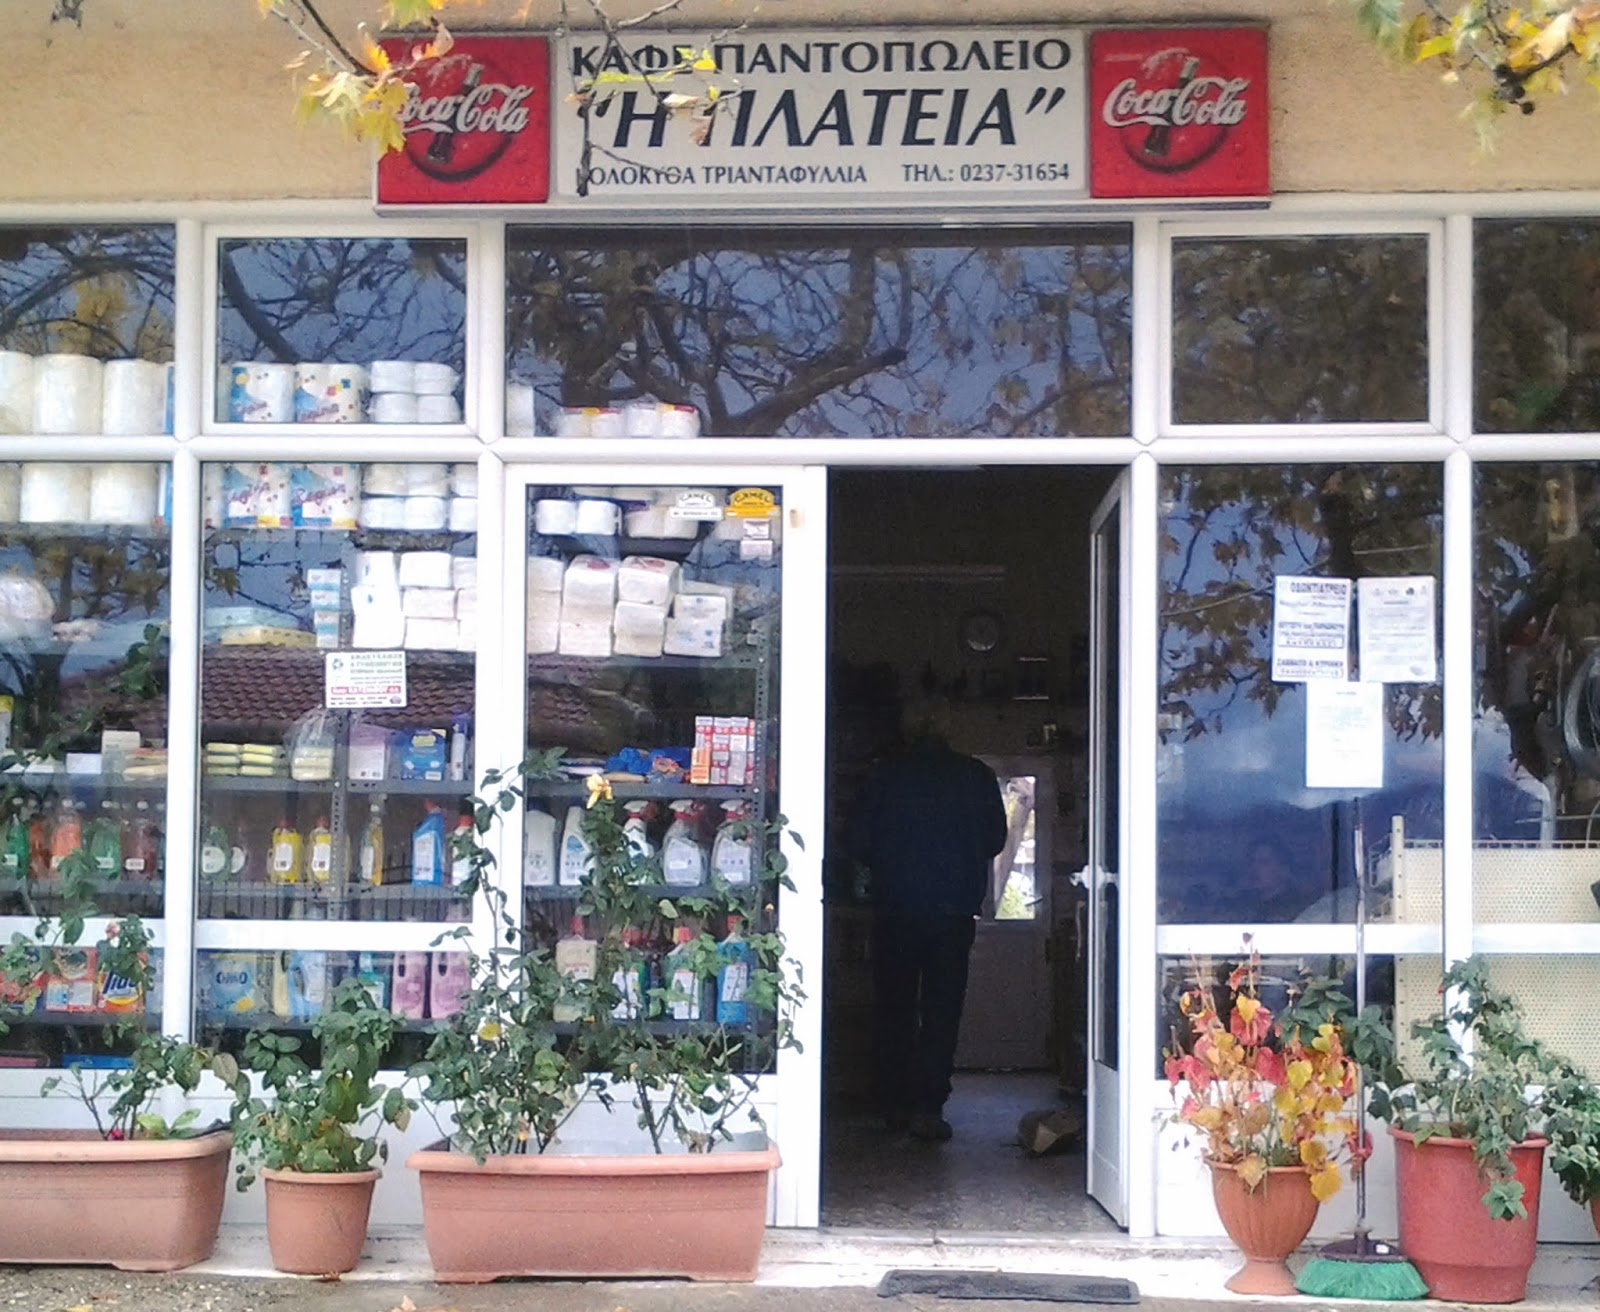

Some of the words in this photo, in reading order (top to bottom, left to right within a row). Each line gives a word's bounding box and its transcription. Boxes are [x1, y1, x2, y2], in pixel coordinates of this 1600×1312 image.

[713, 38, 1071, 74] ΠΑΝΤΟΠΩΛΕΙΟ
[702, 164, 867, 184] ΤΡΙΑΝΤΑΦΥΛΛΙΑ
[960, 162, 1070, 182] 0237-31654
